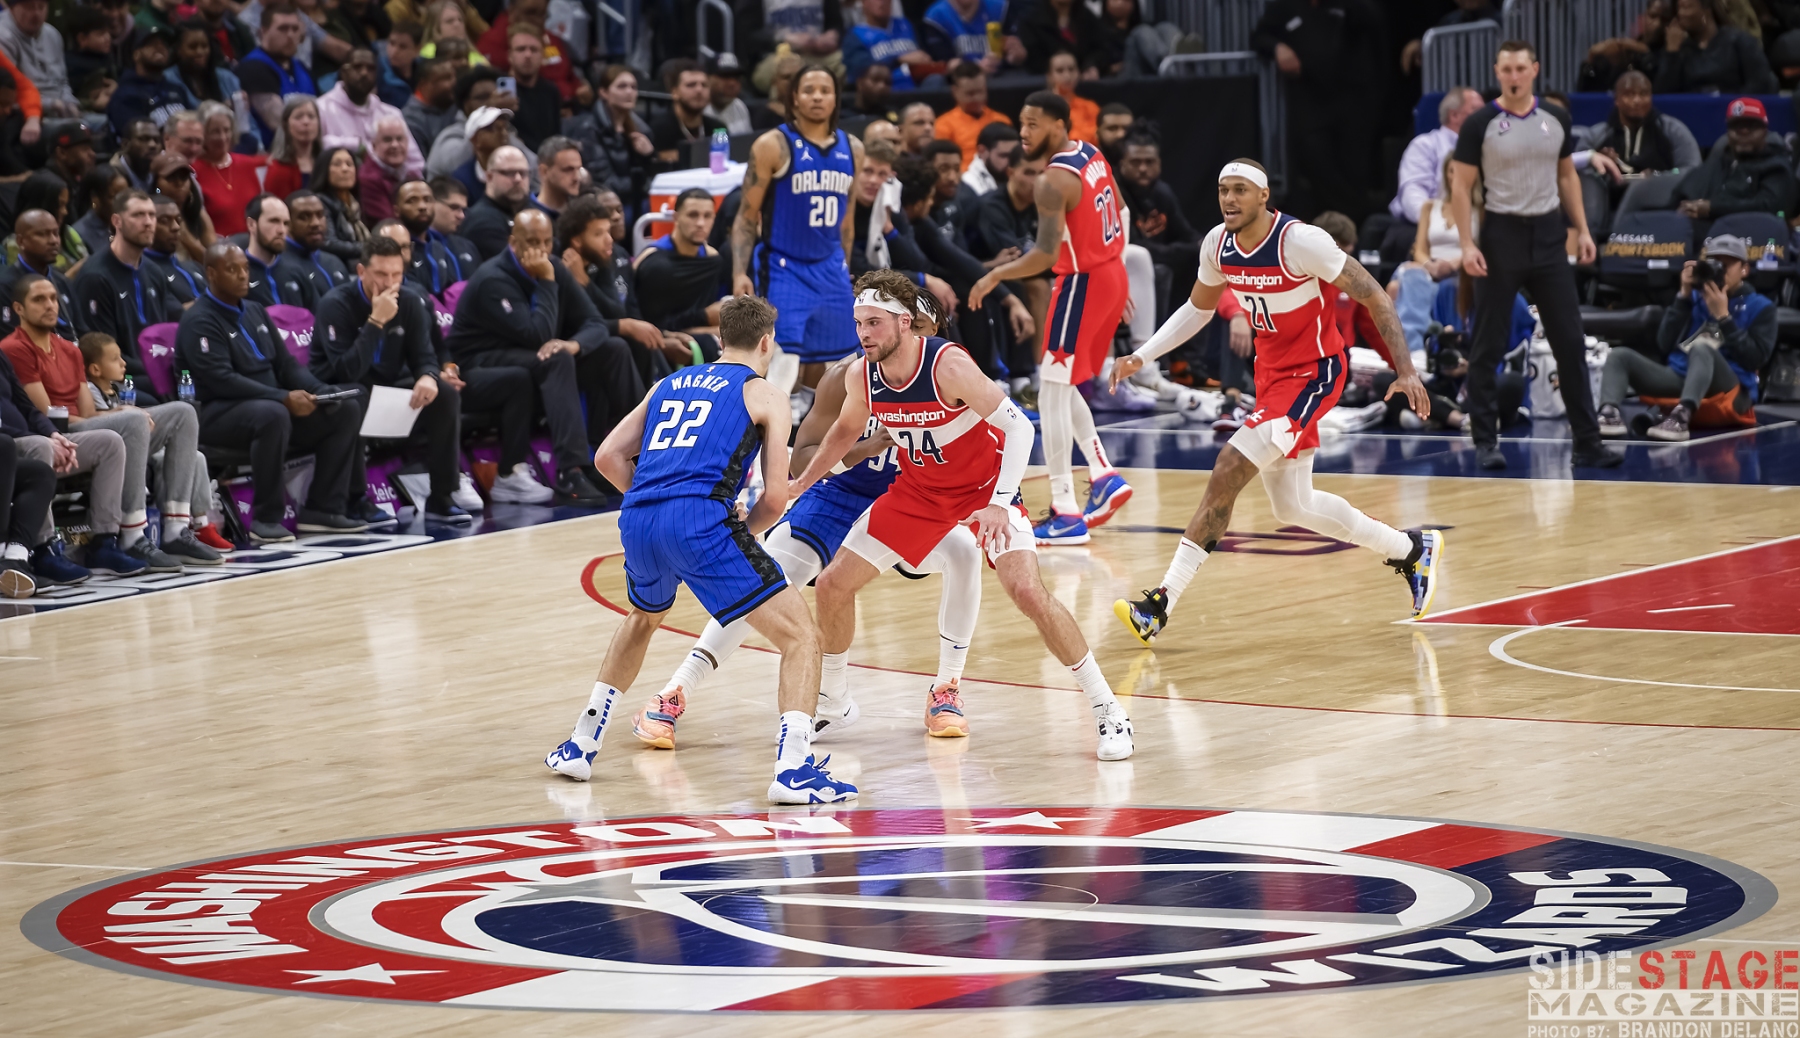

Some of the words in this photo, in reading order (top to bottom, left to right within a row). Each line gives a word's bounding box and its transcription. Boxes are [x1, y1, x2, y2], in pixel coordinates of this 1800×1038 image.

[809, 195, 839, 228] 20
[1094, 185, 1121, 246] 22
[1609, 233, 1655, 243] CAESARS
[1244, 295, 1278, 333] 21
[671, 374, 730, 393] WAGNER
[873, 371, 879, 382] 6
[647, 399, 713, 451] 22
[877, 407, 946, 426] washington
[898, 430, 949, 467] 24
[103, 816, 853, 965] WASHINGTON
[1116, 867, 1688, 991] WIZARDS
